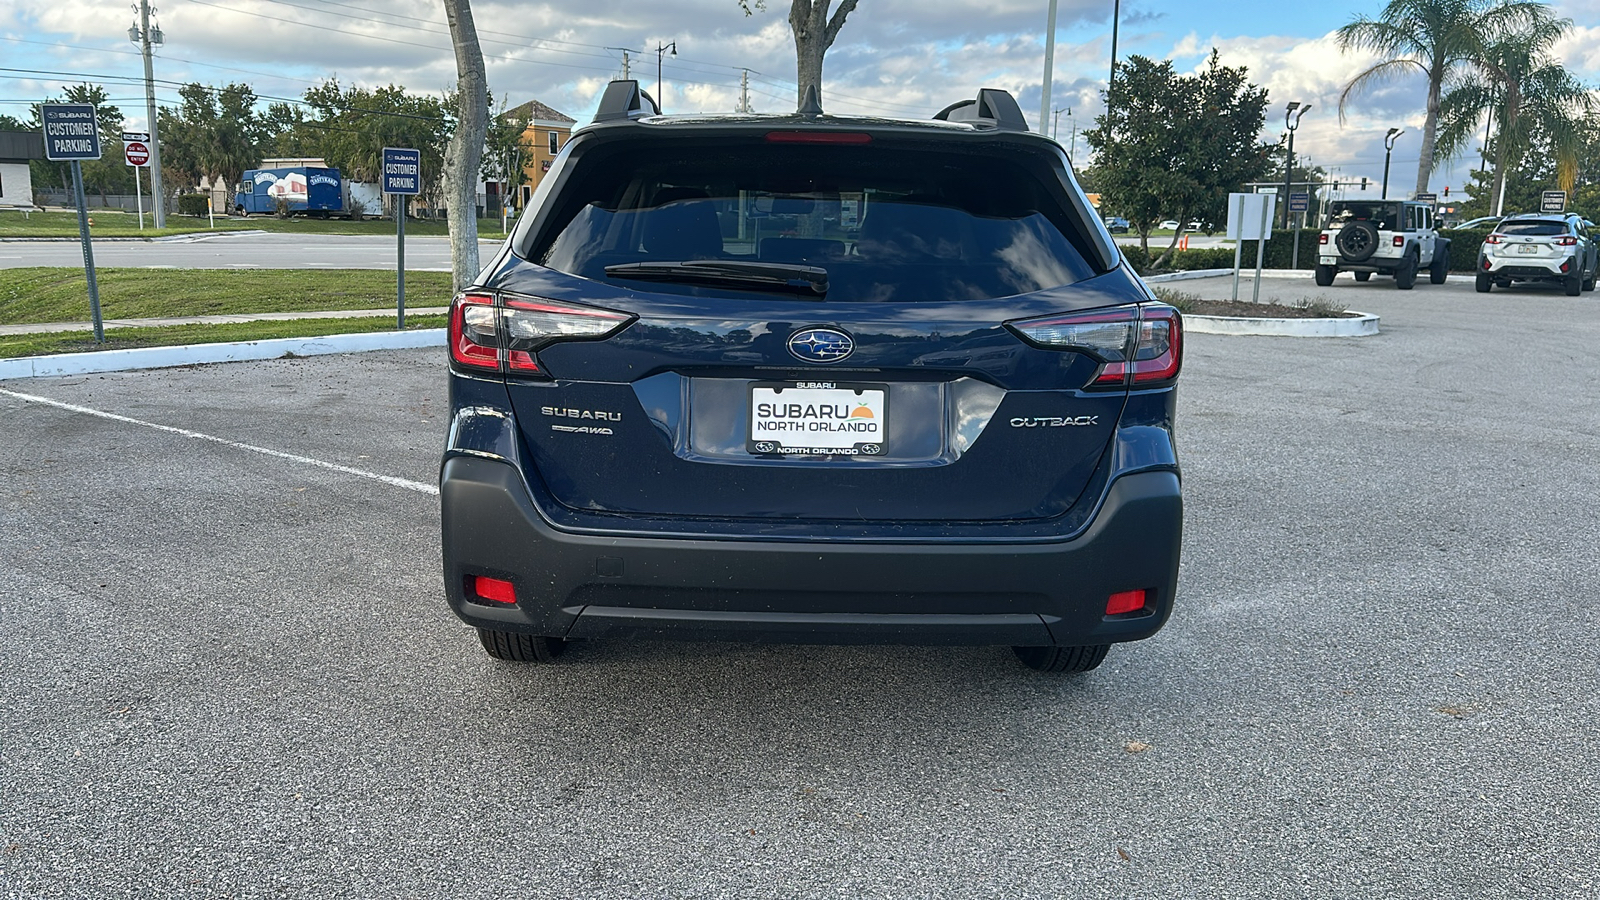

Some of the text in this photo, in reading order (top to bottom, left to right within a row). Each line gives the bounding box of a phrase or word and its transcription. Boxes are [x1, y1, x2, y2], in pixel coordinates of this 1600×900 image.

[47, 122, 94, 136] CUSTOMER
[54, 139, 92, 153] PARKING
[386, 163, 417, 175] CUSTOMER
[388, 177, 415, 189] PARKING
[541, 406, 622, 422] SUBARU
[757, 403, 849, 419] SUBARU
[757, 421, 878, 433] NORTH ORLANDO
[1009, 415, 1099, 428] OUTBACK
[574, 426, 614, 435] AWD
[777, 447, 859, 455] NORTH ORLANDO
